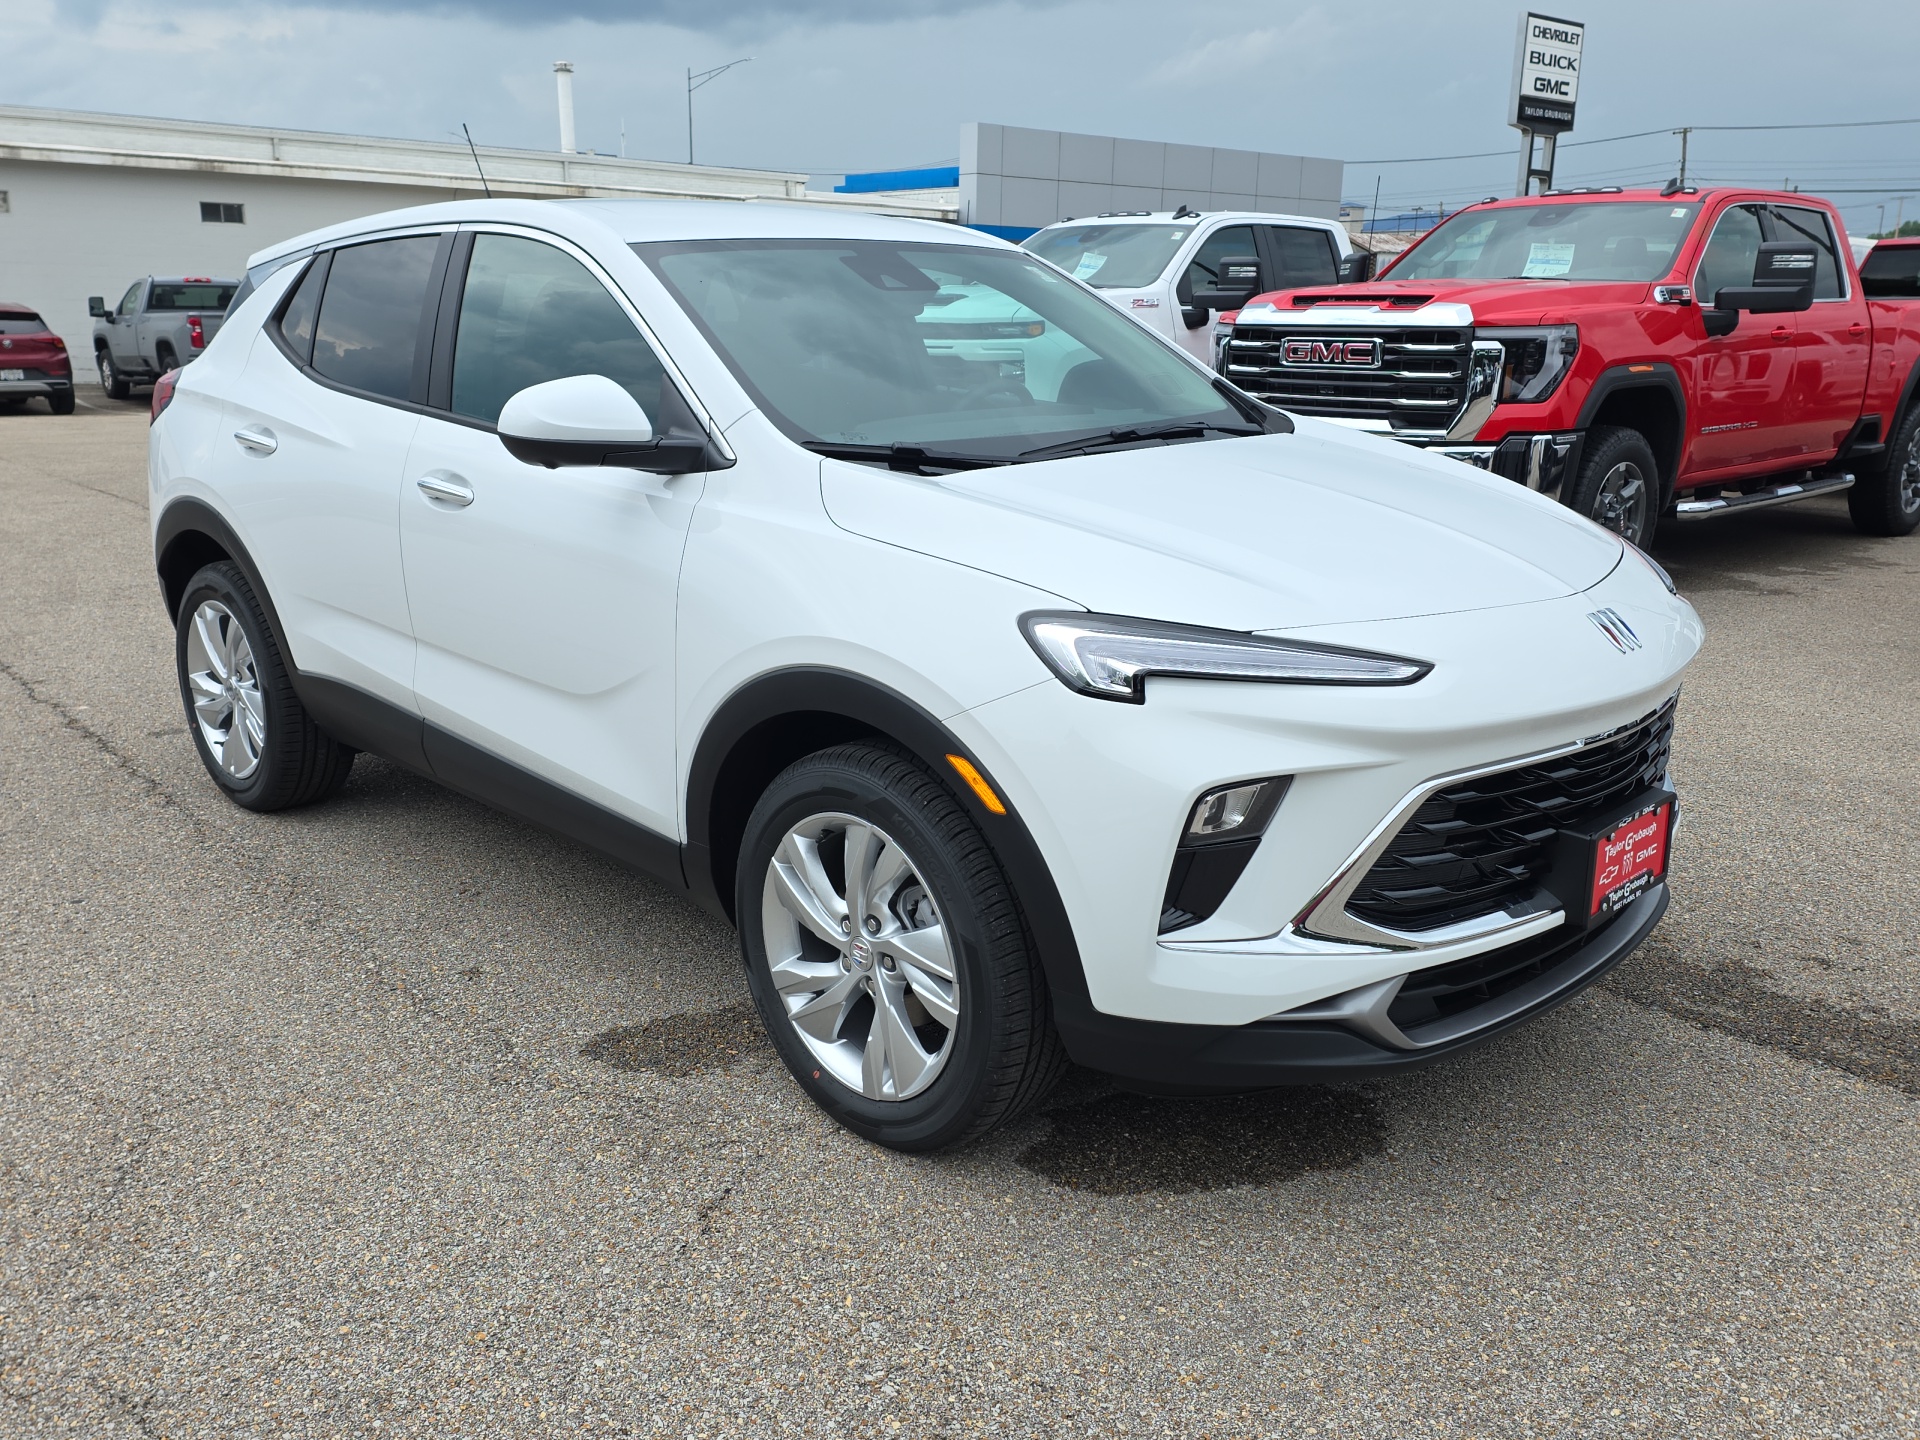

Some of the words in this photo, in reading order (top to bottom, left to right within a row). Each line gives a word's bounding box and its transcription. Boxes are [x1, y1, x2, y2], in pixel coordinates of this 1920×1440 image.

[1532, 25, 1581, 46] CHEVROLET
[1529, 50, 1578, 72] BUICK
[1533, 76, 1570, 96] GMC
[1525, 106, 1543, 117] TAYLOR
[1544, 109, 1572, 121] GRUBAUGH
[1285, 342, 1374, 363] GMC
[1701, 422, 1742, 434] SIERRA
[1605, 841, 1625, 863] Taylor
[1625, 822, 1657, 850] Grubaugh
[1636, 843, 1658, 863] GMC
